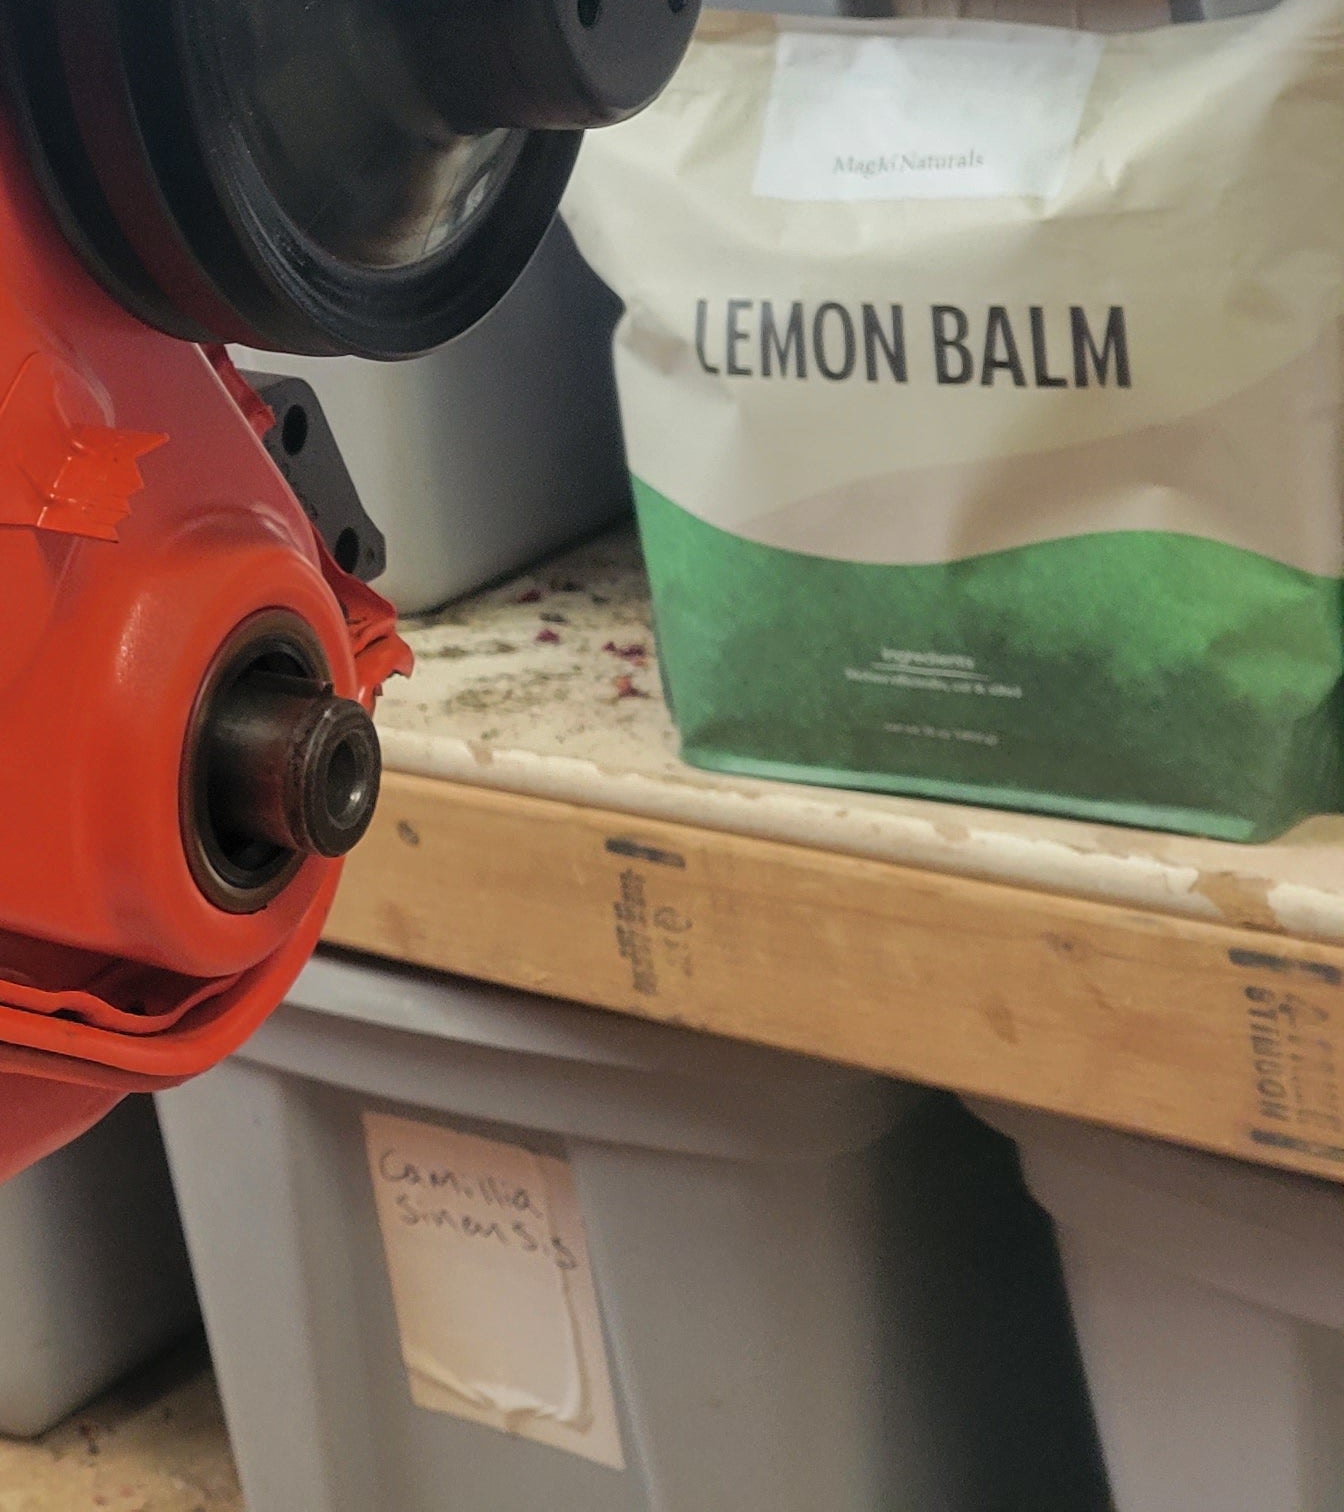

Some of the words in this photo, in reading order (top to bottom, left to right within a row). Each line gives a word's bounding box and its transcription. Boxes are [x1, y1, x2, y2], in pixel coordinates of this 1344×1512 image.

[900, 148, 985, 172] Naturals
[695, 298, 908, 383] LEMON
[931, 304, 1132, 389] BALM
